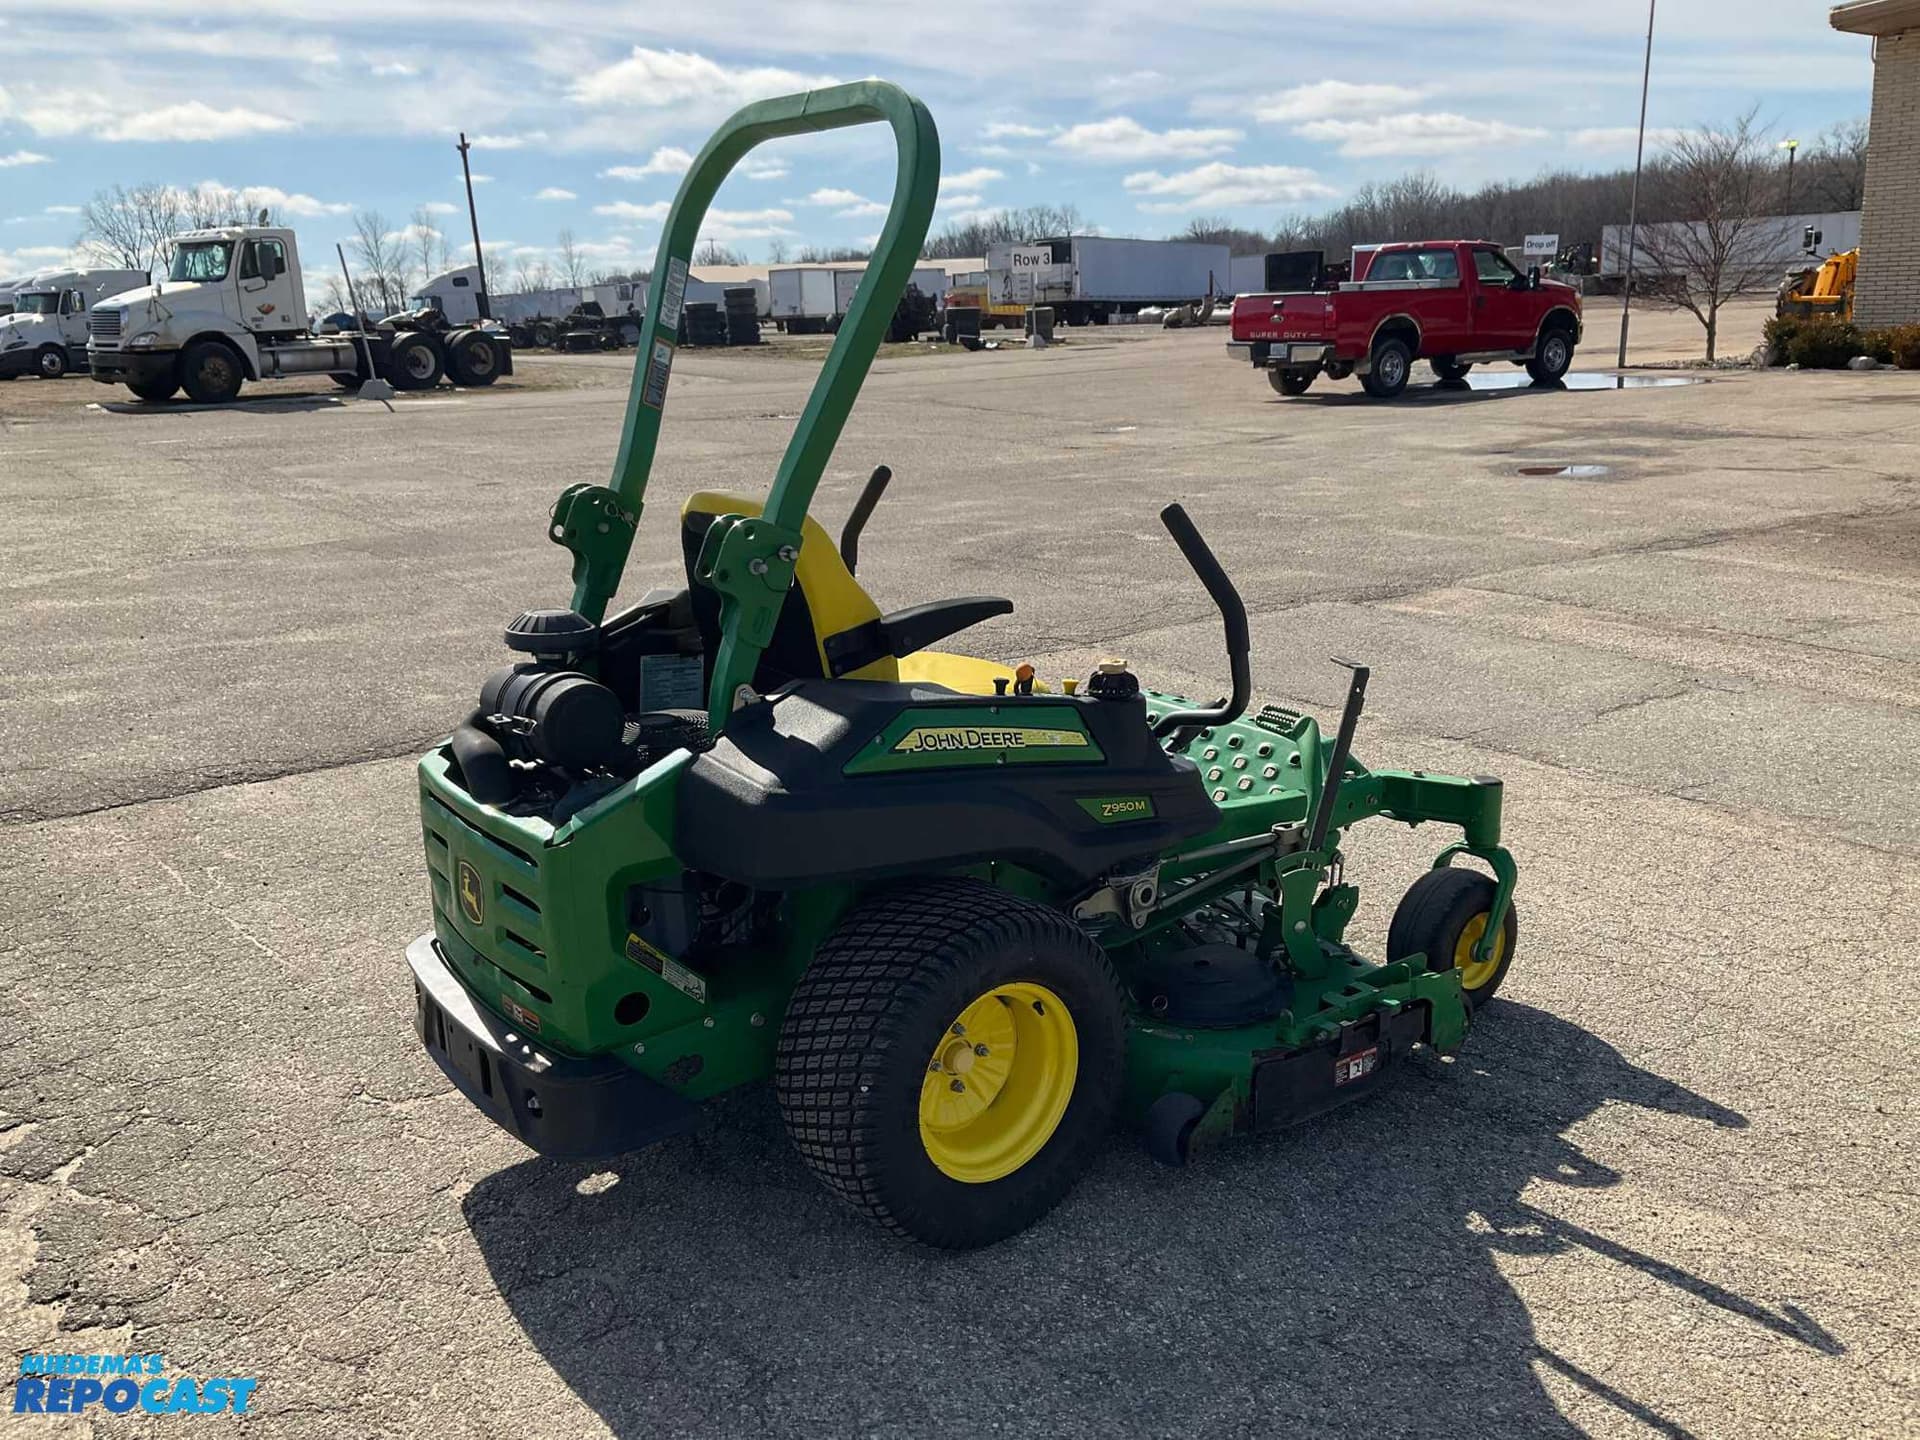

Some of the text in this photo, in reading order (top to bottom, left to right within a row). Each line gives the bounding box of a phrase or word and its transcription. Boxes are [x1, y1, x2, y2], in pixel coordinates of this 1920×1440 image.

[1526, 240, 1556, 249] Drop off
[1013, 252, 1050, 266] Row 3
[914, 730, 1025, 749] JOHN DEERE
[1102, 800, 1145, 816] Z950M
